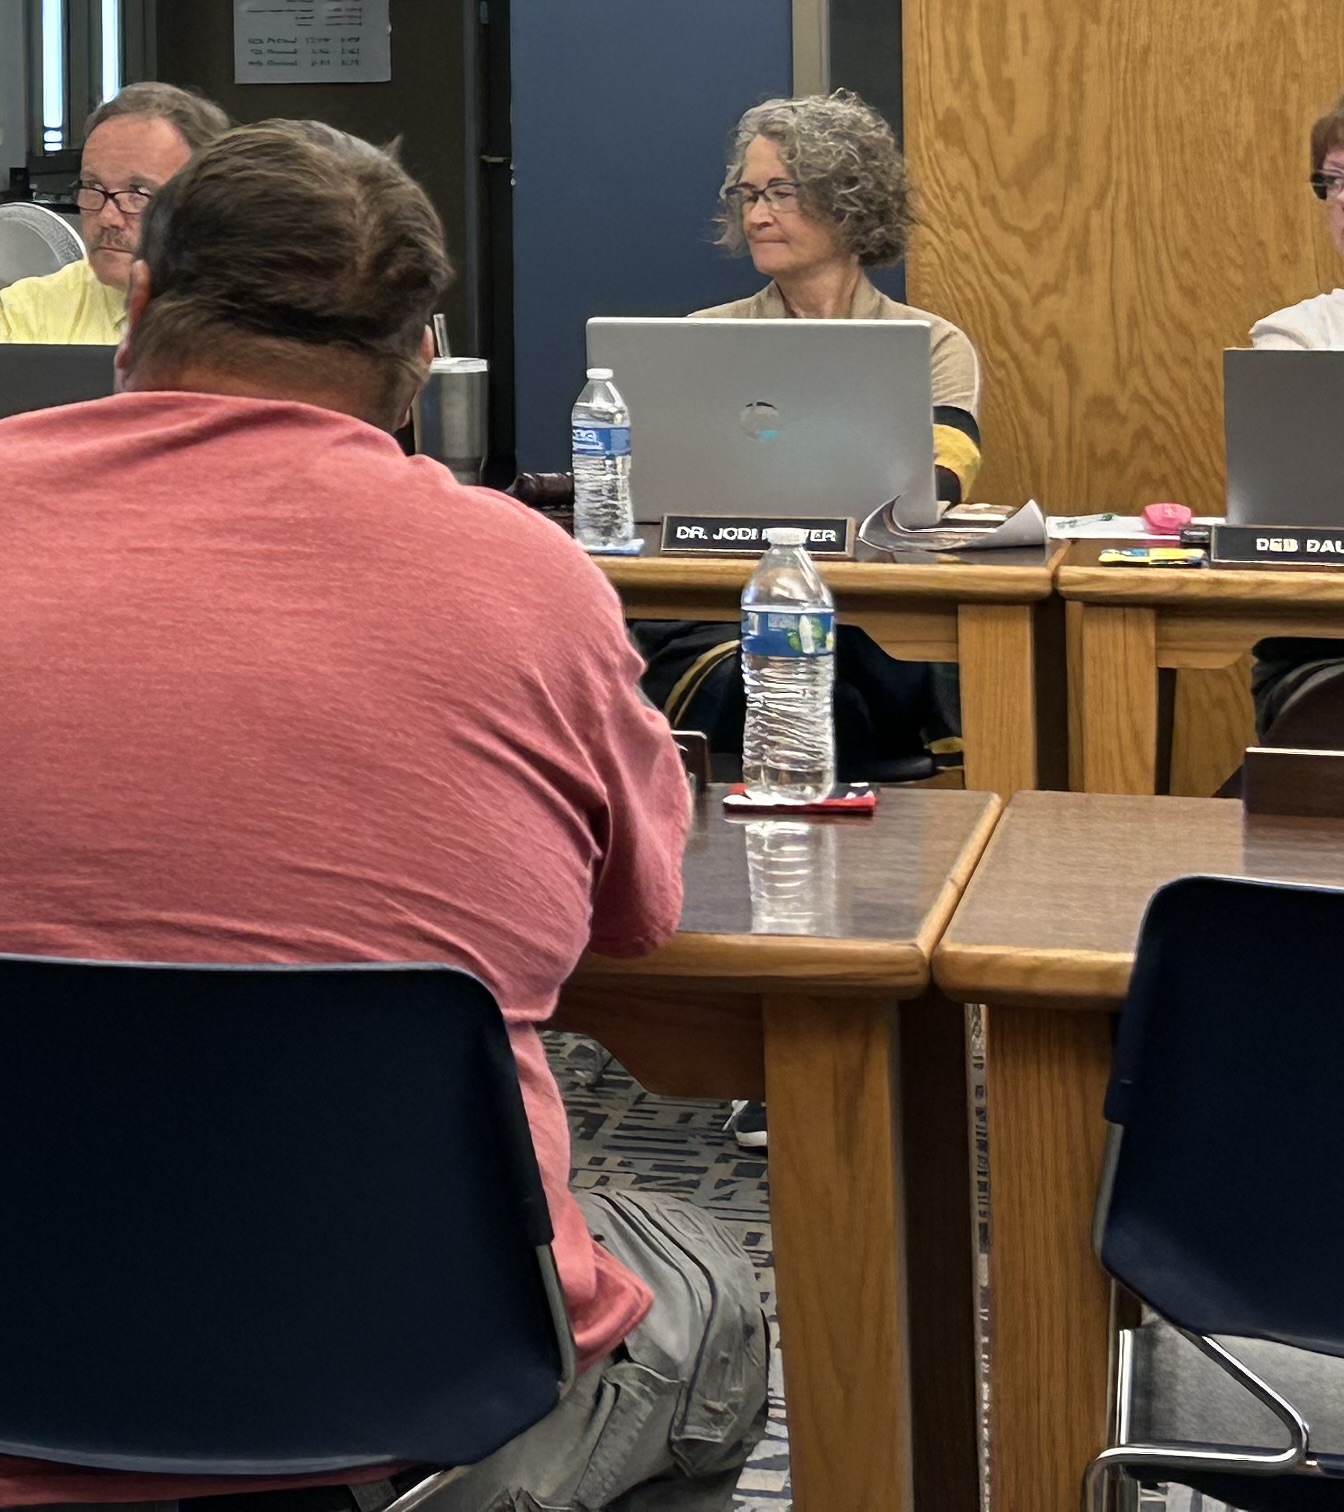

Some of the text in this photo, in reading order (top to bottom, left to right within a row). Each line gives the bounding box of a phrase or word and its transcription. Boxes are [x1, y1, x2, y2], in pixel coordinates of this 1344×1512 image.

[676, 526, 708, 540] DR.
[713, 527, 758, 541] JODI
[1256, 538, 1299, 552] DEB
